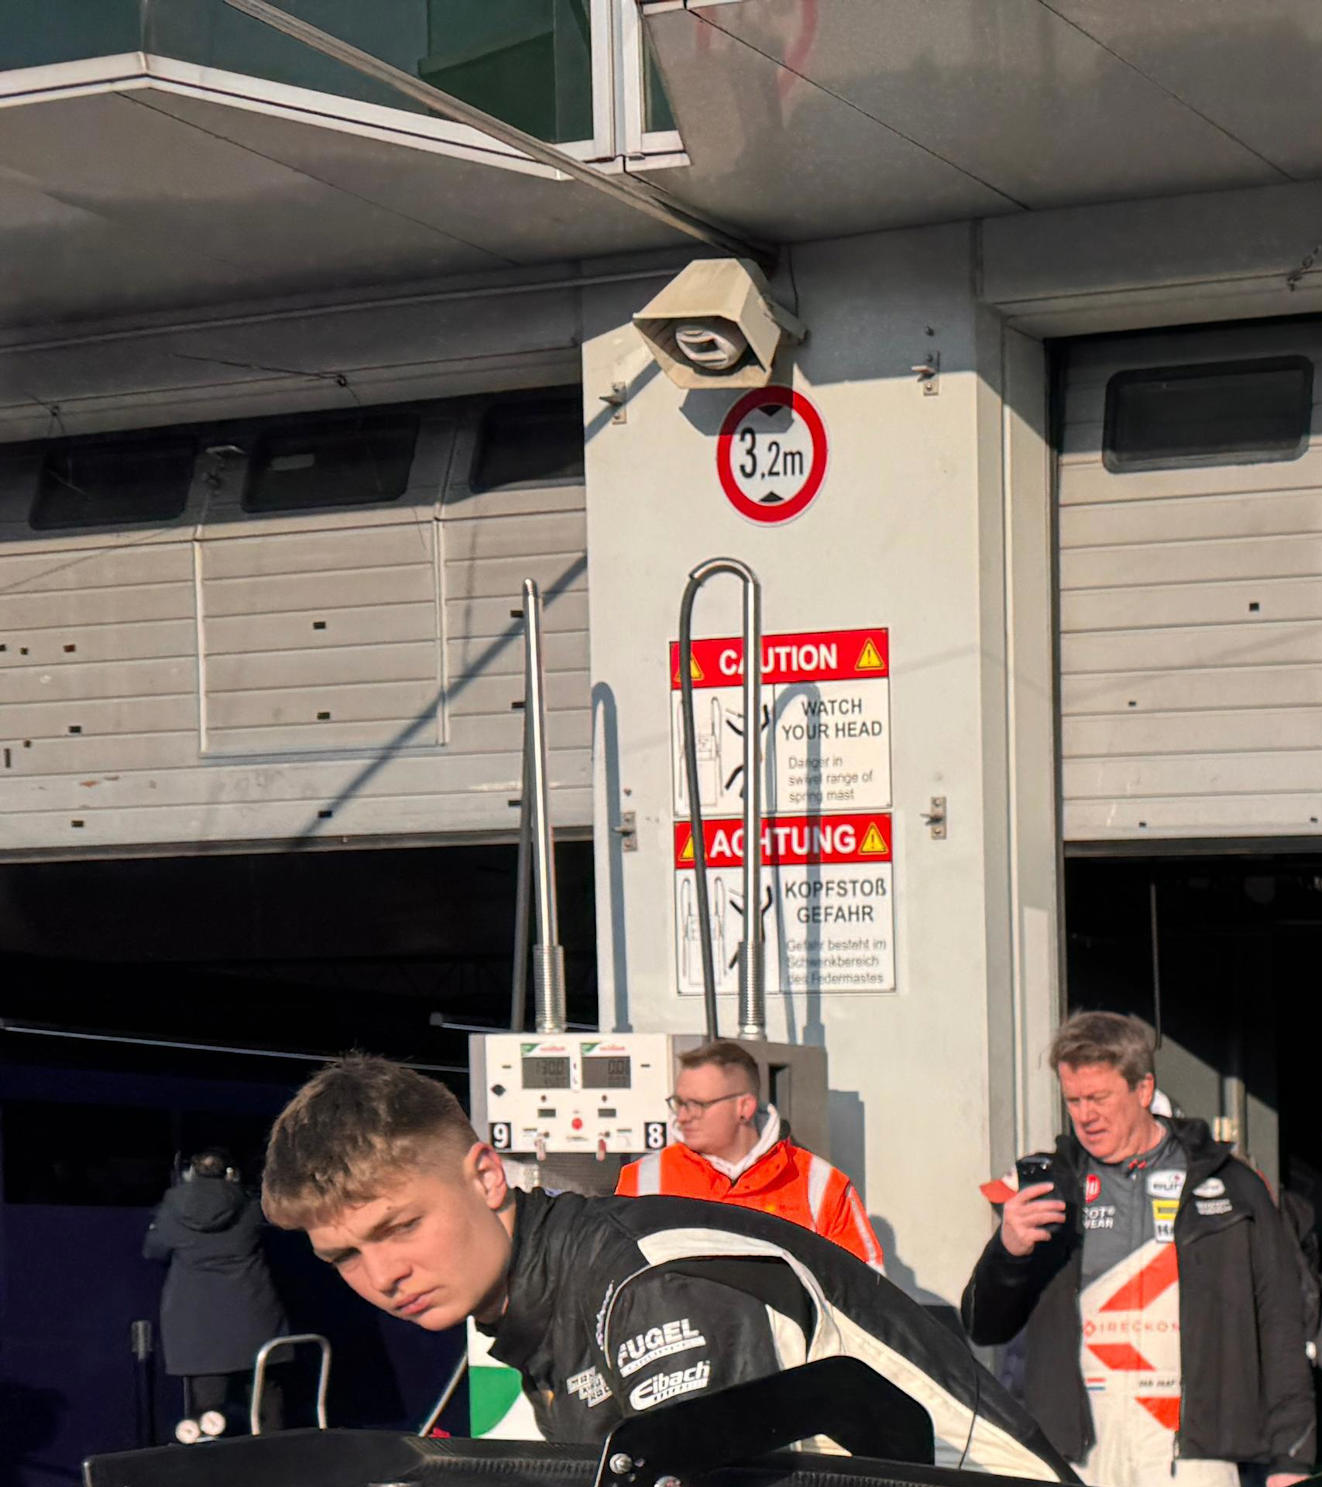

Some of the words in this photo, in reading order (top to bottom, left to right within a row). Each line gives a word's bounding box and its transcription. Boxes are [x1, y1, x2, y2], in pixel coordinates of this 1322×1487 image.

[739, 427, 804, 480] 3,2m
[719, 643, 838, 676] CUTION
[801, 699, 863, 717] WATCH
[782, 724, 830, 741] YOUR
[835, 721, 883, 738] HEAD
[788, 757, 830, 770] Danger
[833, 756, 843, 767] in
[826, 773, 859, 788] range
[861, 771, 873, 783] of
[826, 788, 854, 800] mast
[784, 878, 887, 899] KOPFSTOß
[797, 905, 875, 924] GEFAHR
[827, 938, 870, 951] besteht
[873, 938, 887, 949] im
[492, 1123, 509, 1149] 9
[647, 1123, 664, 1149] 8
[617, 1318, 700, 1369] FUGEL
[629, 1360, 711, 1411] Eibach
